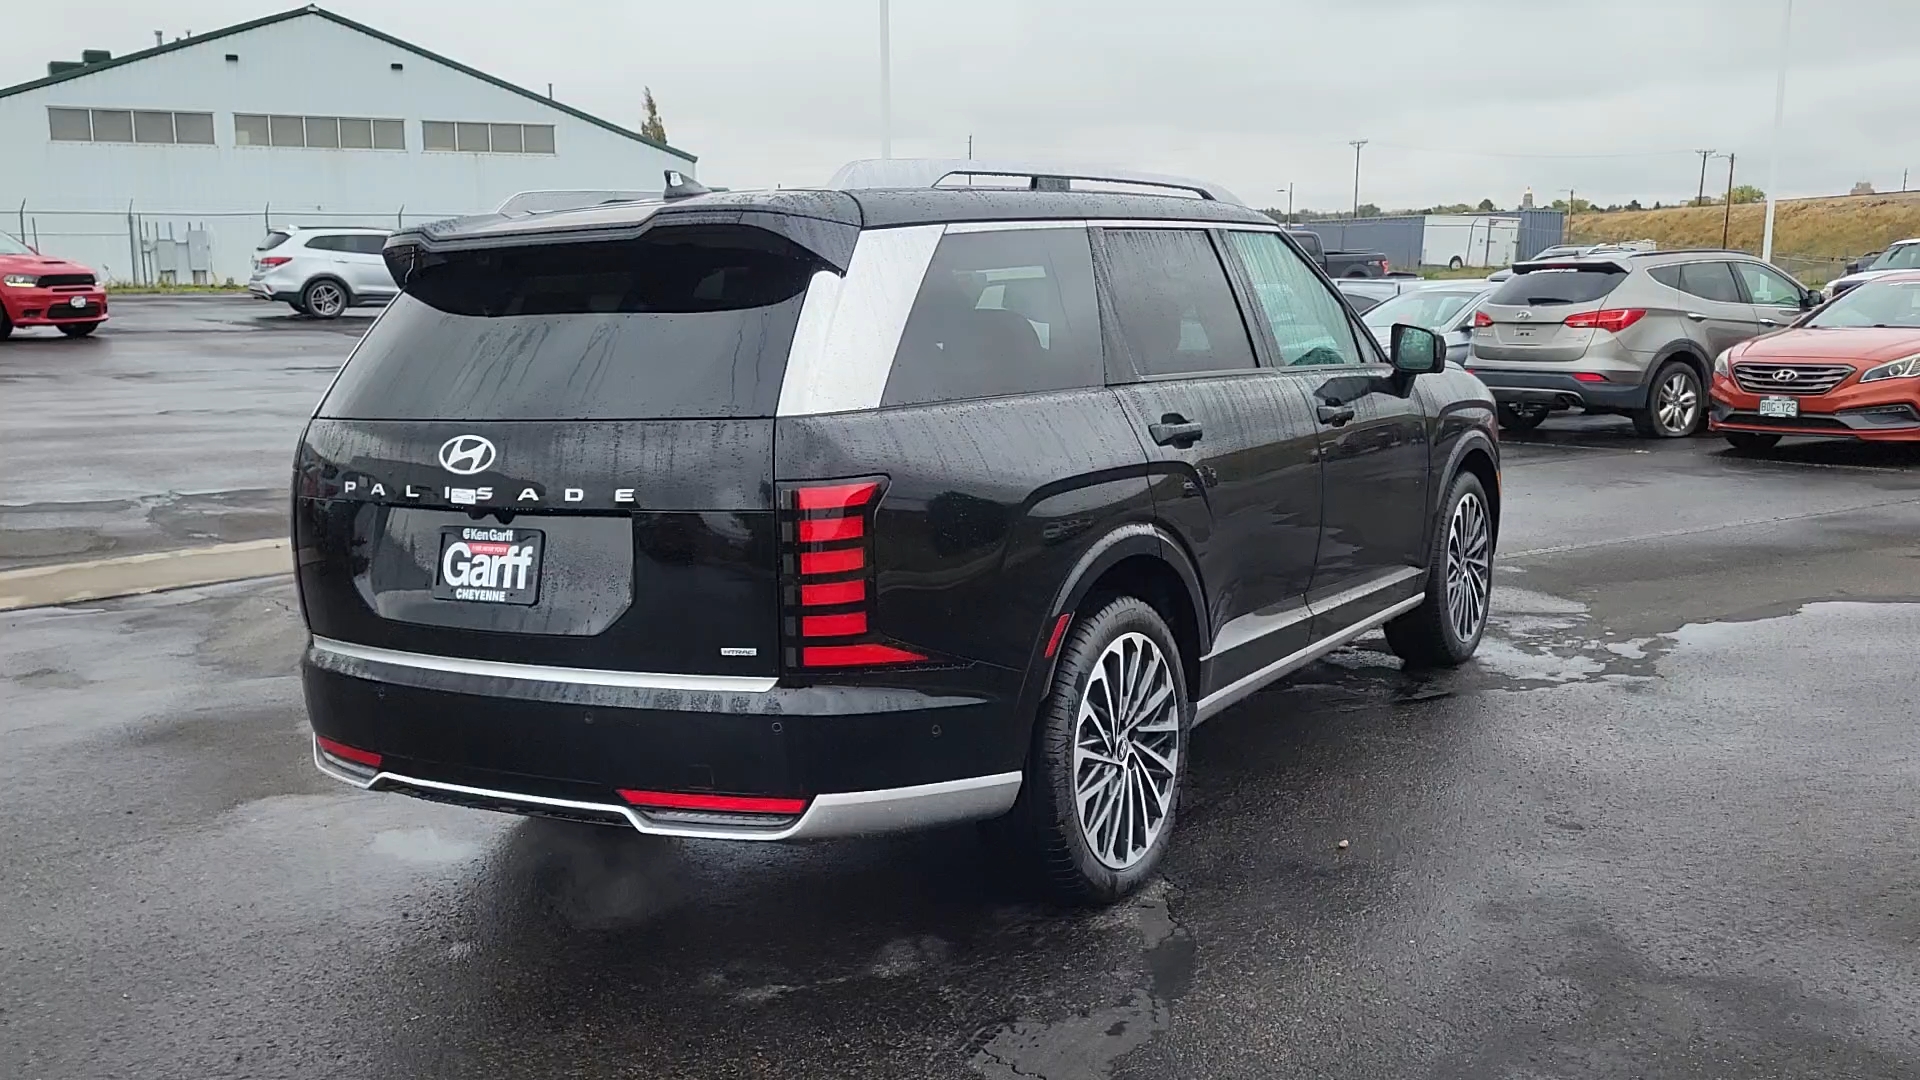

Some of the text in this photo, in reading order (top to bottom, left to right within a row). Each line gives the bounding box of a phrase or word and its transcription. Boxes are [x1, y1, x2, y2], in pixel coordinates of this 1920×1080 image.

[344, 481, 635, 502] PALISADE
[471, 529, 513, 542] Ken Garff
[443, 542, 533, 589] Garff
[456, 588, 505, 602] CHEYENNE
